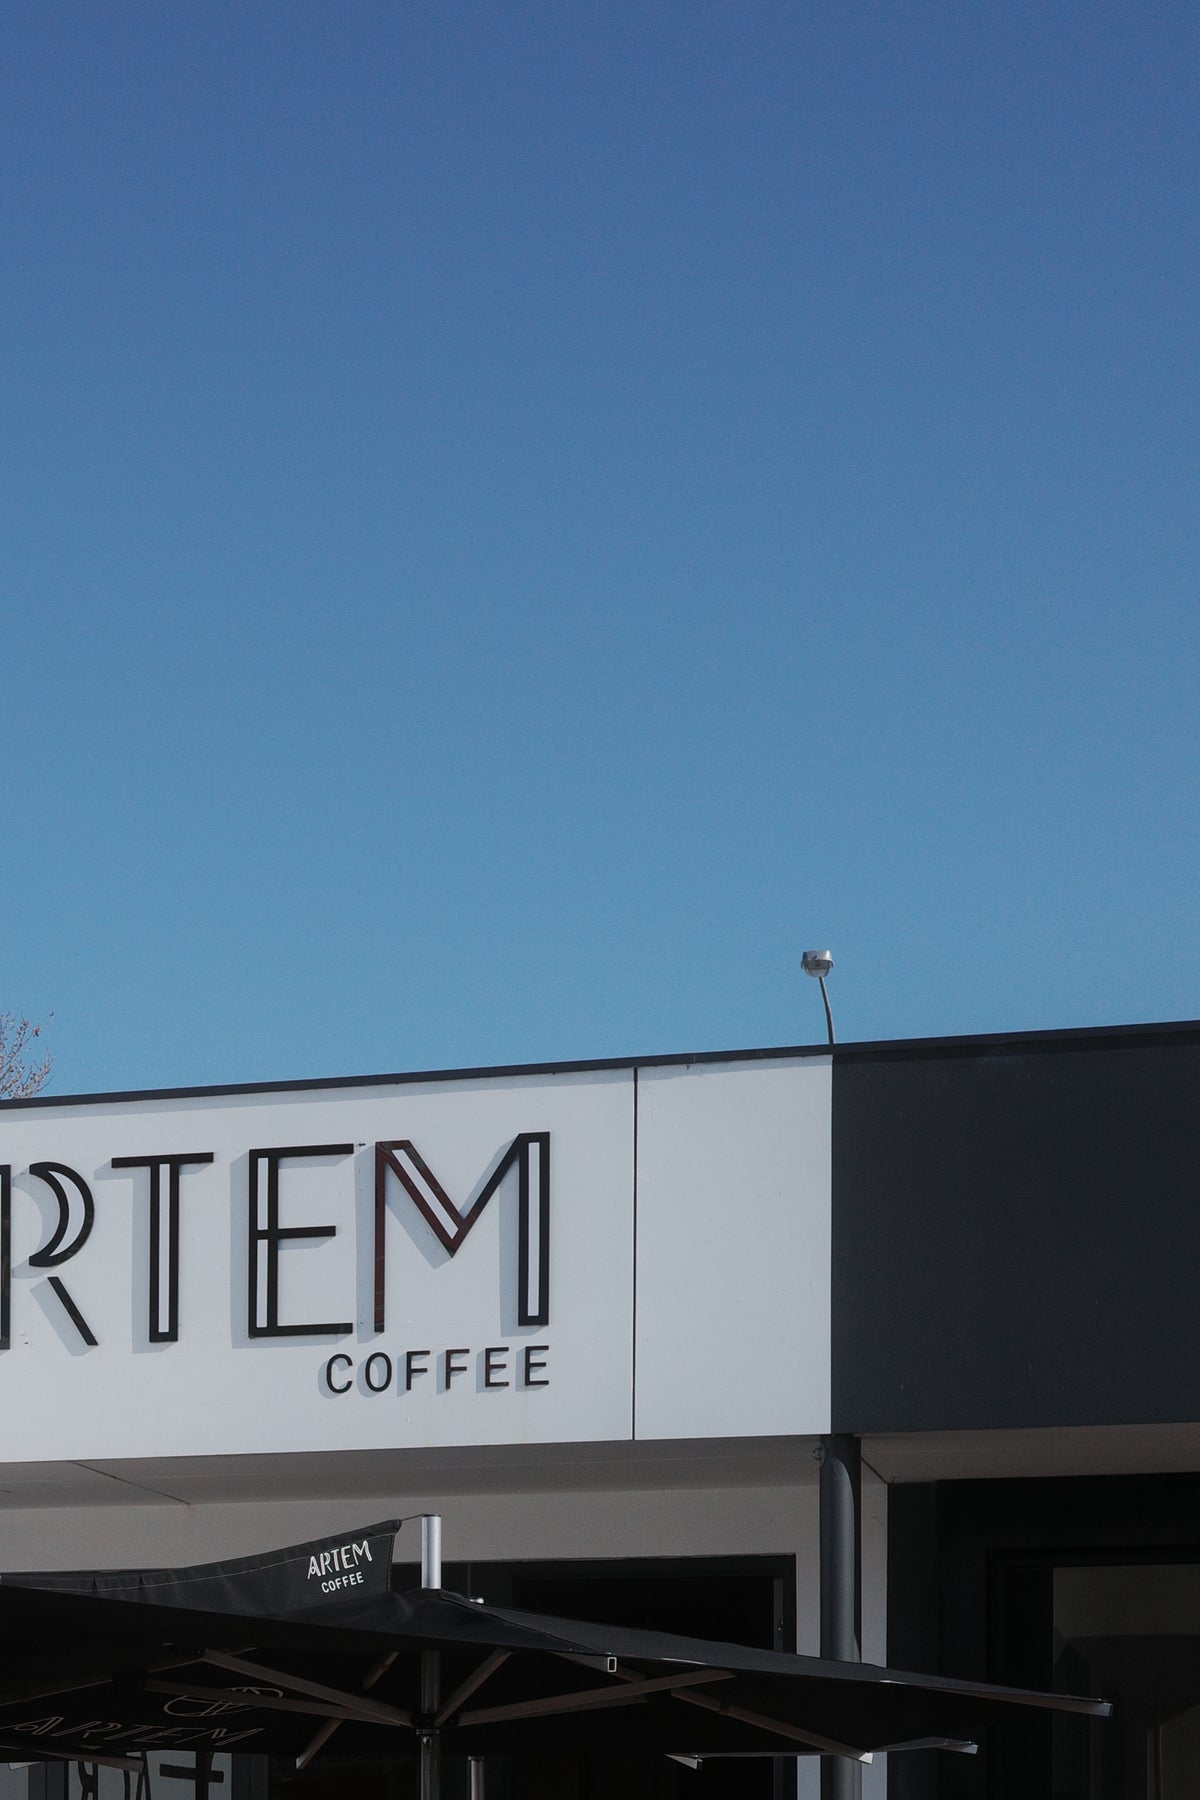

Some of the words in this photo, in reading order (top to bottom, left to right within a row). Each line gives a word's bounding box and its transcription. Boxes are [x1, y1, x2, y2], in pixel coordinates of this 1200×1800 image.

[325, 1344, 550, 1394] COFFEE
[307, 1540, 373, 1580] ARTEM
[321, 1571, 365, 1593] COFFEE
